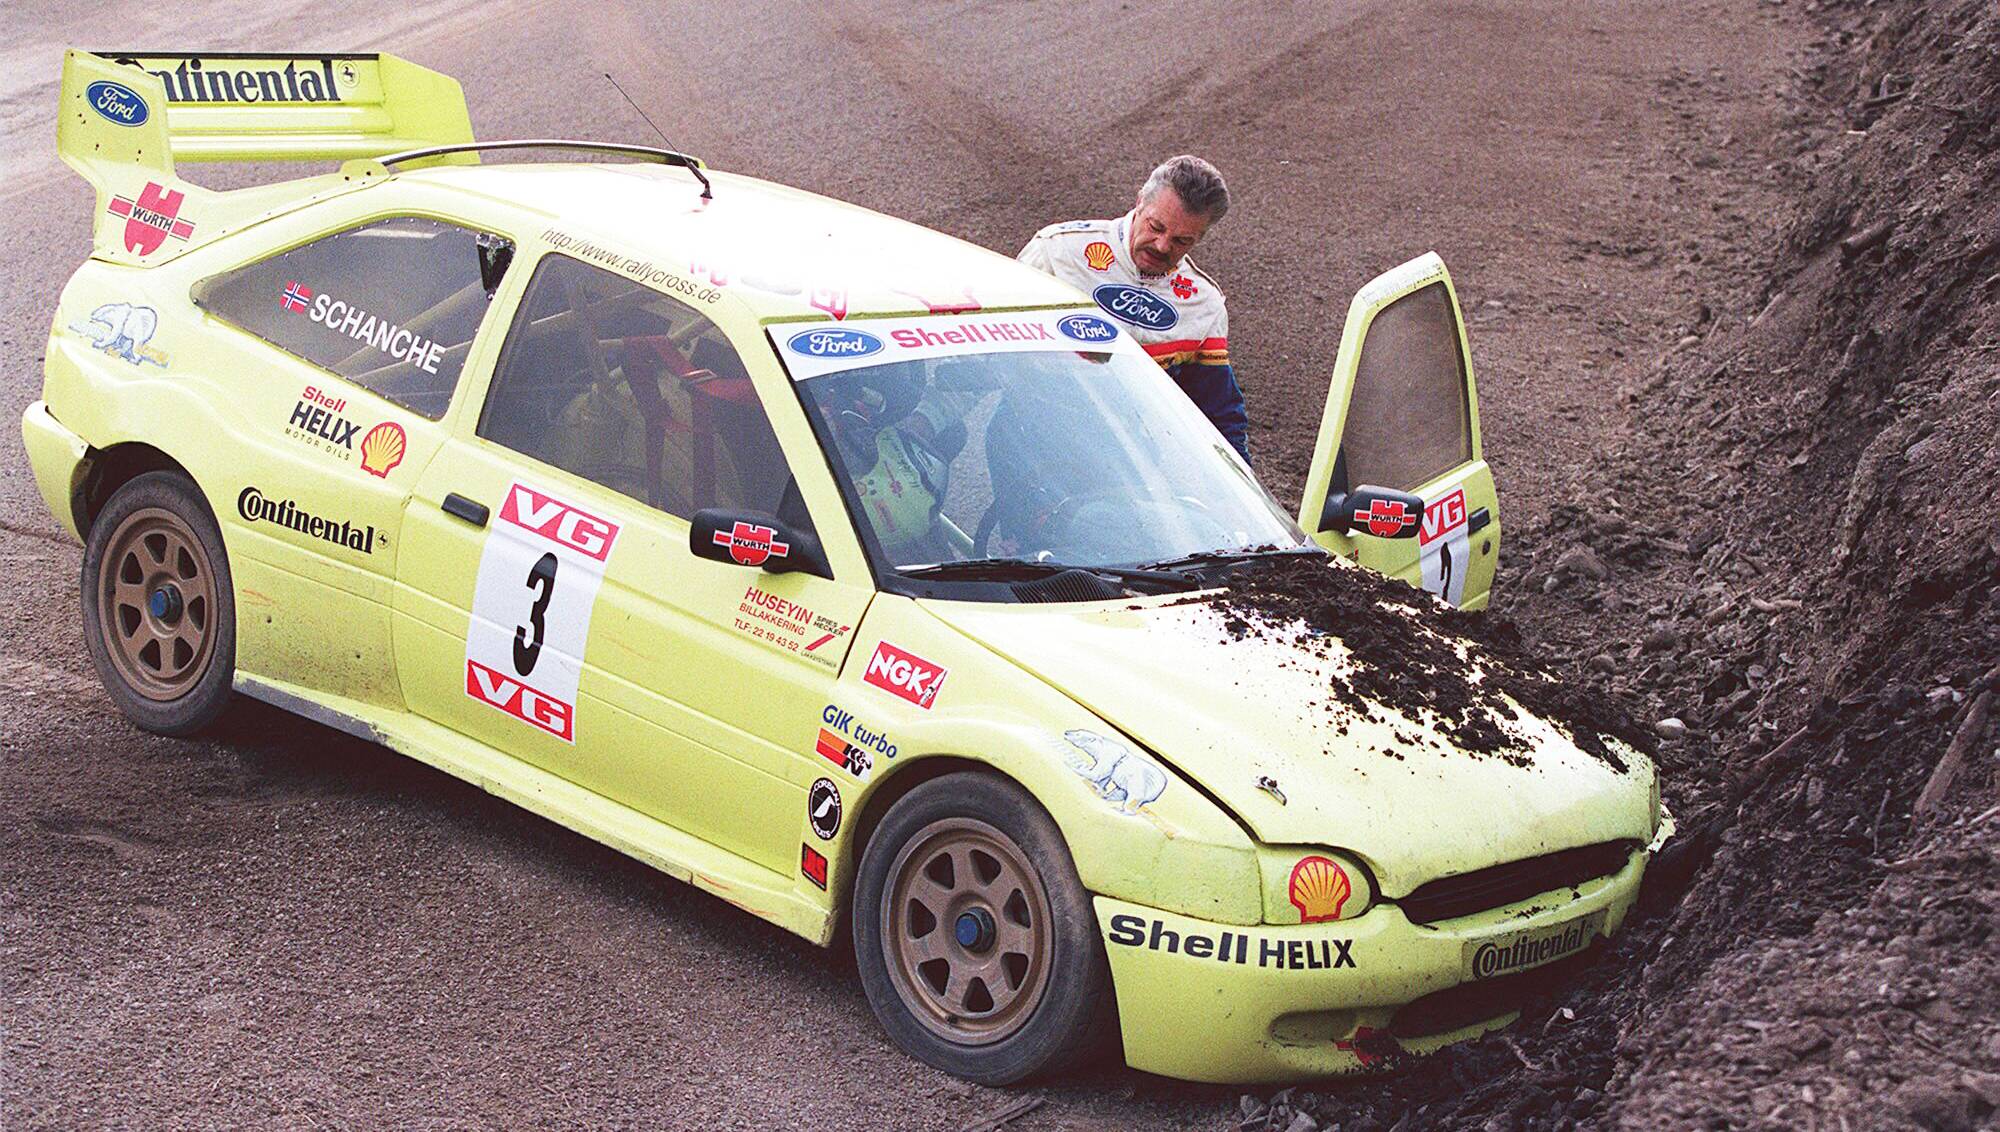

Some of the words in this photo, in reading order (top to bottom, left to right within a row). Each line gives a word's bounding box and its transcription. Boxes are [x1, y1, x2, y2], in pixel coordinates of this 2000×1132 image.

[114, 57, 341, 103] ntinental
[96, 87, 136, 121] Ford
[540, 228, 722, 305] http://www.rallycross.de
[1112, 288, 1166, 323] Ford
[309, 294, 446, 375] SCHANCHE
[810, 333, 867, 354] Ford
[891, 324, 986, 349] Shell
[982, 323, 1055, 343] HELIX
[1069, 319, 1111, 339] Ford
[303, 385, 347, 413] Shell
[285, 427, 320, 447] MOTOR
[325, 445, 350, 461] OILS
[289, 400, 362, 450] HELIX
[237, 486, 373, 554] Continental
[515, 487, 610, 556] VG
[1422, 495, 1463, 539] VG
[512, 552, 558, 677] 3
[739, 602, 806, 636] BILLAKKERING
[744, 586, 814, 625] HUSEYIN
[816, 615, 838, 628] SPIES
[752, 626, 764, 638] 22
[766, 631, 775, 642] 19
[776, 636, 786, 647] 43
[787, 640, 799, 652] 52
[813, 621, 844, 637] HECKER
[868, 650, 932, 696] NGK
[471, 664, 566, 734] VG
[823, 704, 854, 734] GIK
[854, 724, 897, 759] turbo
[1108, 914, 1248, 964] Shell
[1259, 938, 1357, 970] HELIX
[1472, 919, 1587, 980] Continental
